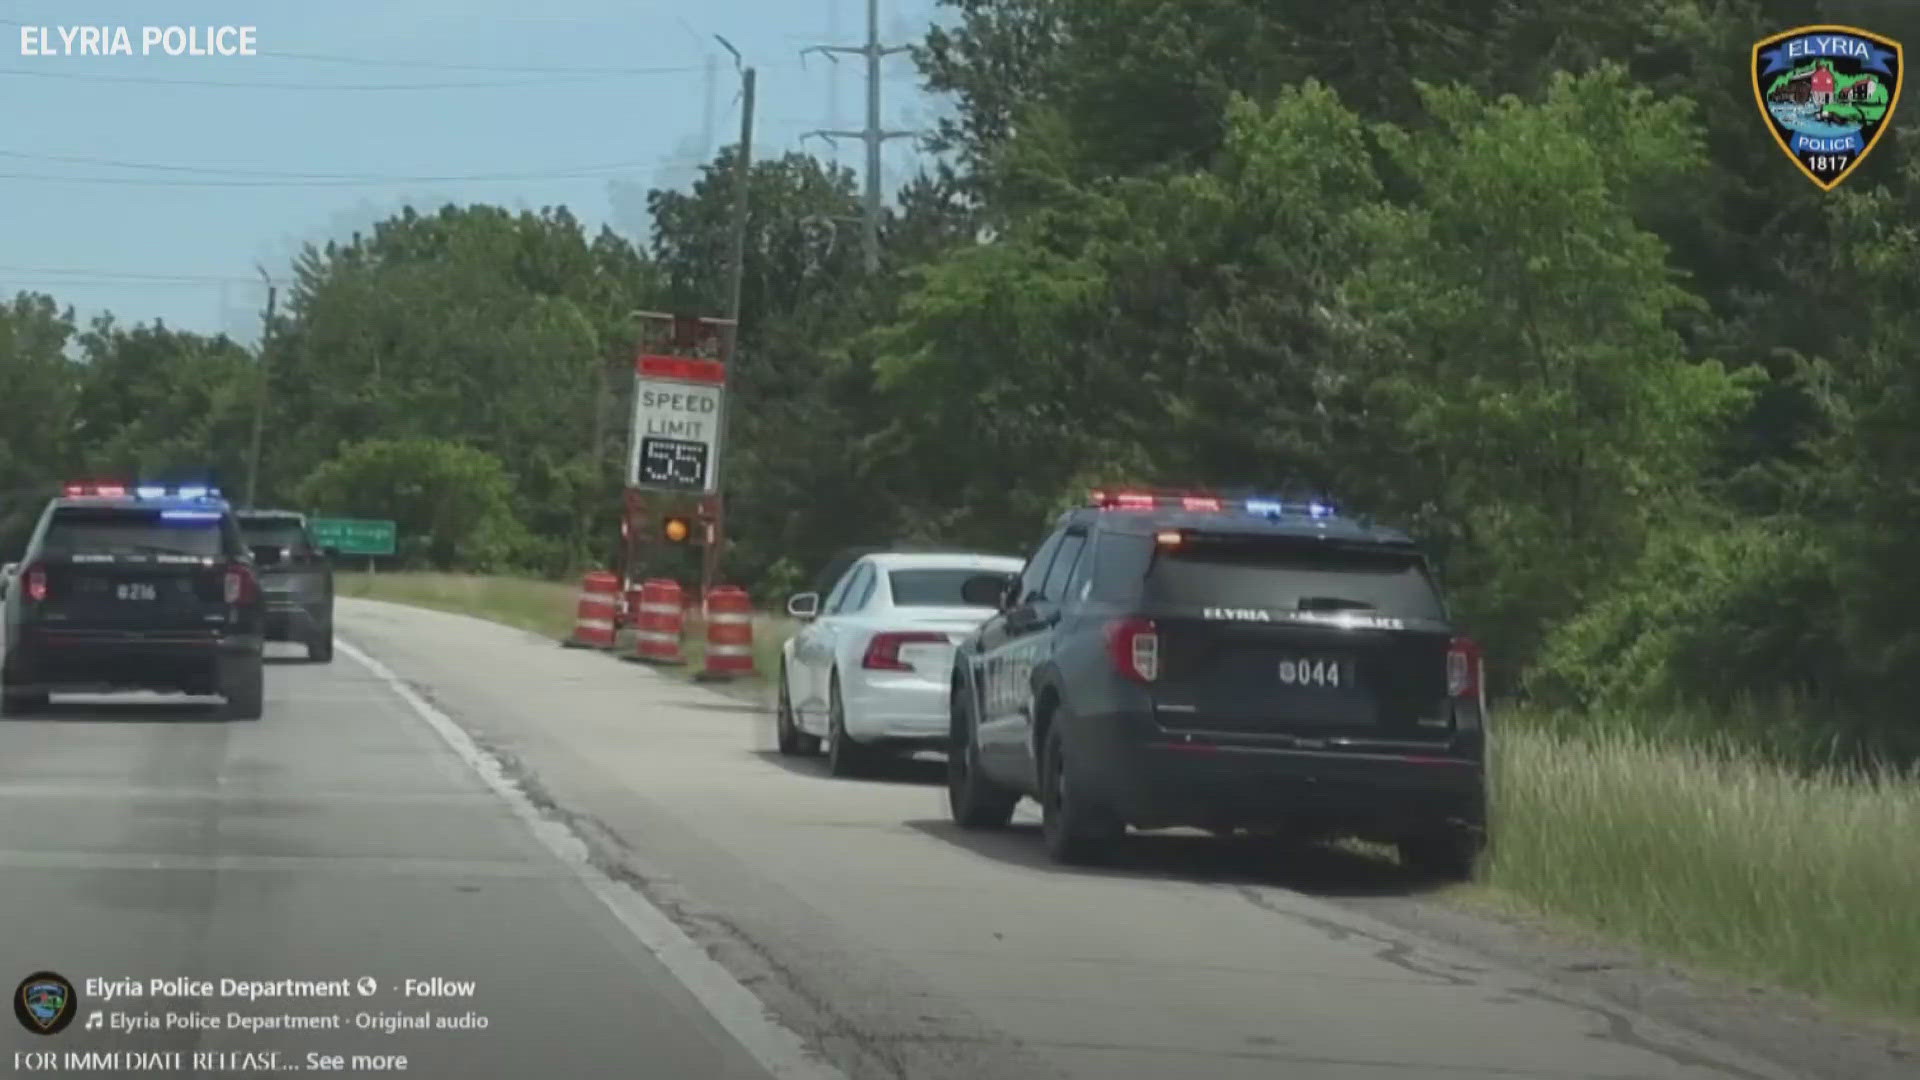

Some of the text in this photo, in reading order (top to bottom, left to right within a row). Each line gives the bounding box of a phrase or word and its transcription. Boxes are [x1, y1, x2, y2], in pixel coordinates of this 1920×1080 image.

[641, 390, 715, 414] SPEED
[647, 418, 704, 438] LIMIT
[645, 440, 704, 484] 55
